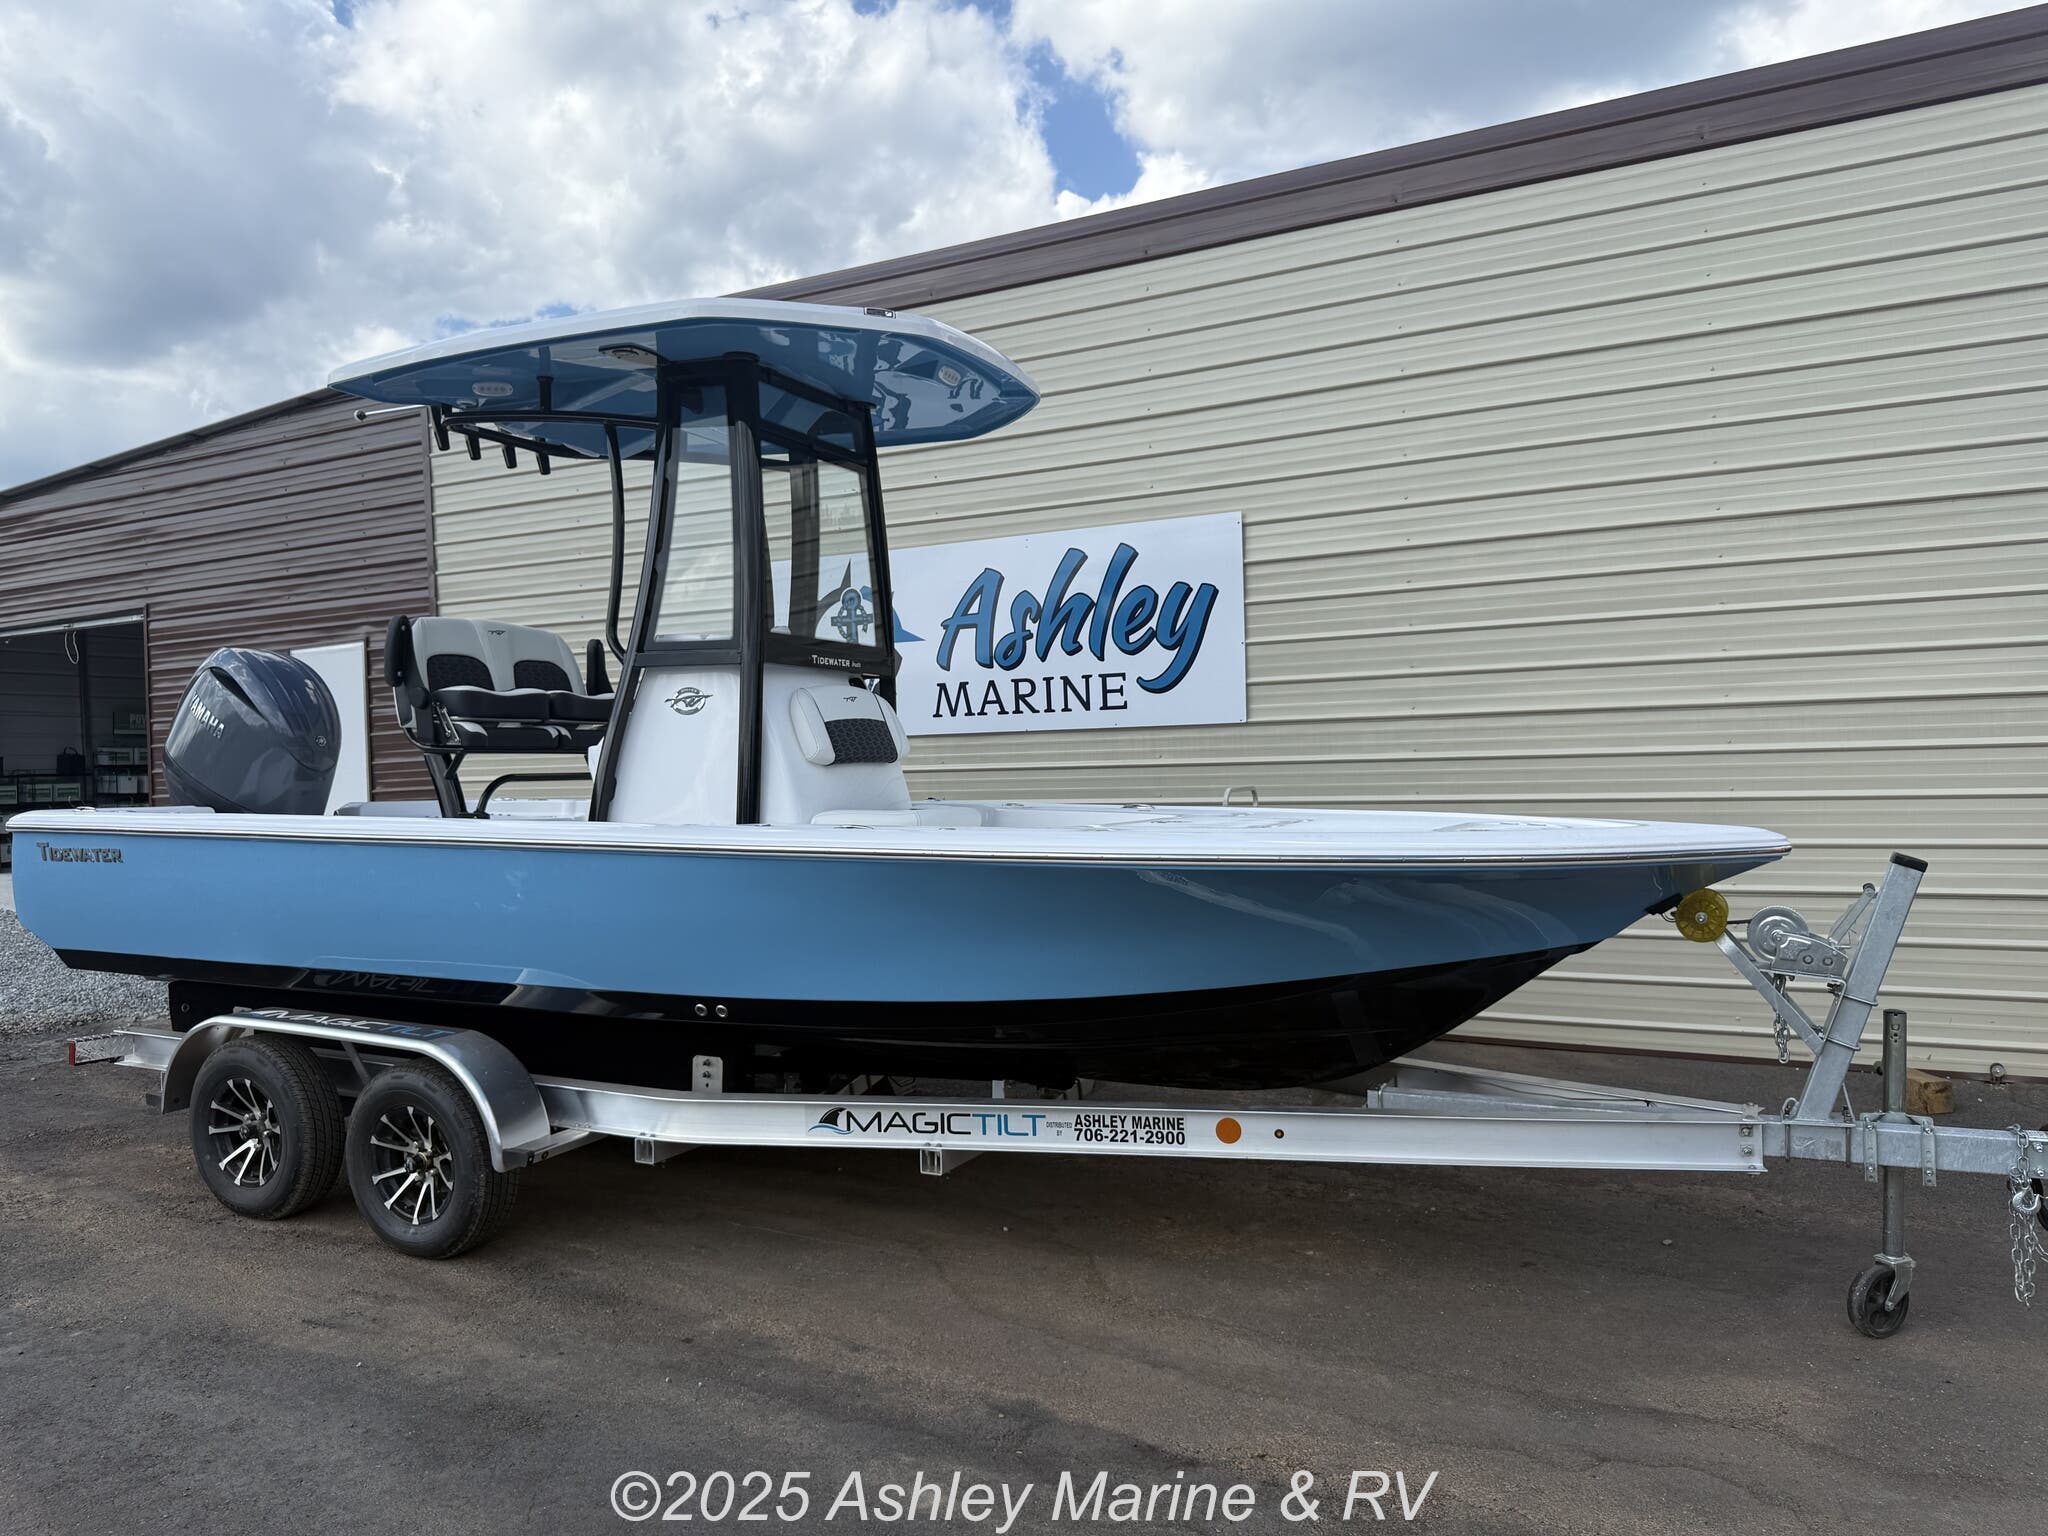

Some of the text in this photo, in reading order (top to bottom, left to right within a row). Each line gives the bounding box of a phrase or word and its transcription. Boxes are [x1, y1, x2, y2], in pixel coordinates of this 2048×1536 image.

[936, 542, 1219, 694] Ashley
[811, 655, 850, 667] TIDEWATER
[932, 672, 1128, 718] MARINE
[190, 691, 225, 739] YAMAHA
[36, 842, 124, 863] TIDEWATER
[846, 1110, 1046, 1136] MAGICTILT
[1074, 1114, 1185, 1131] ASHLEY MARINE
[1073, 1127, 1186, 1146] 706-221-2900
